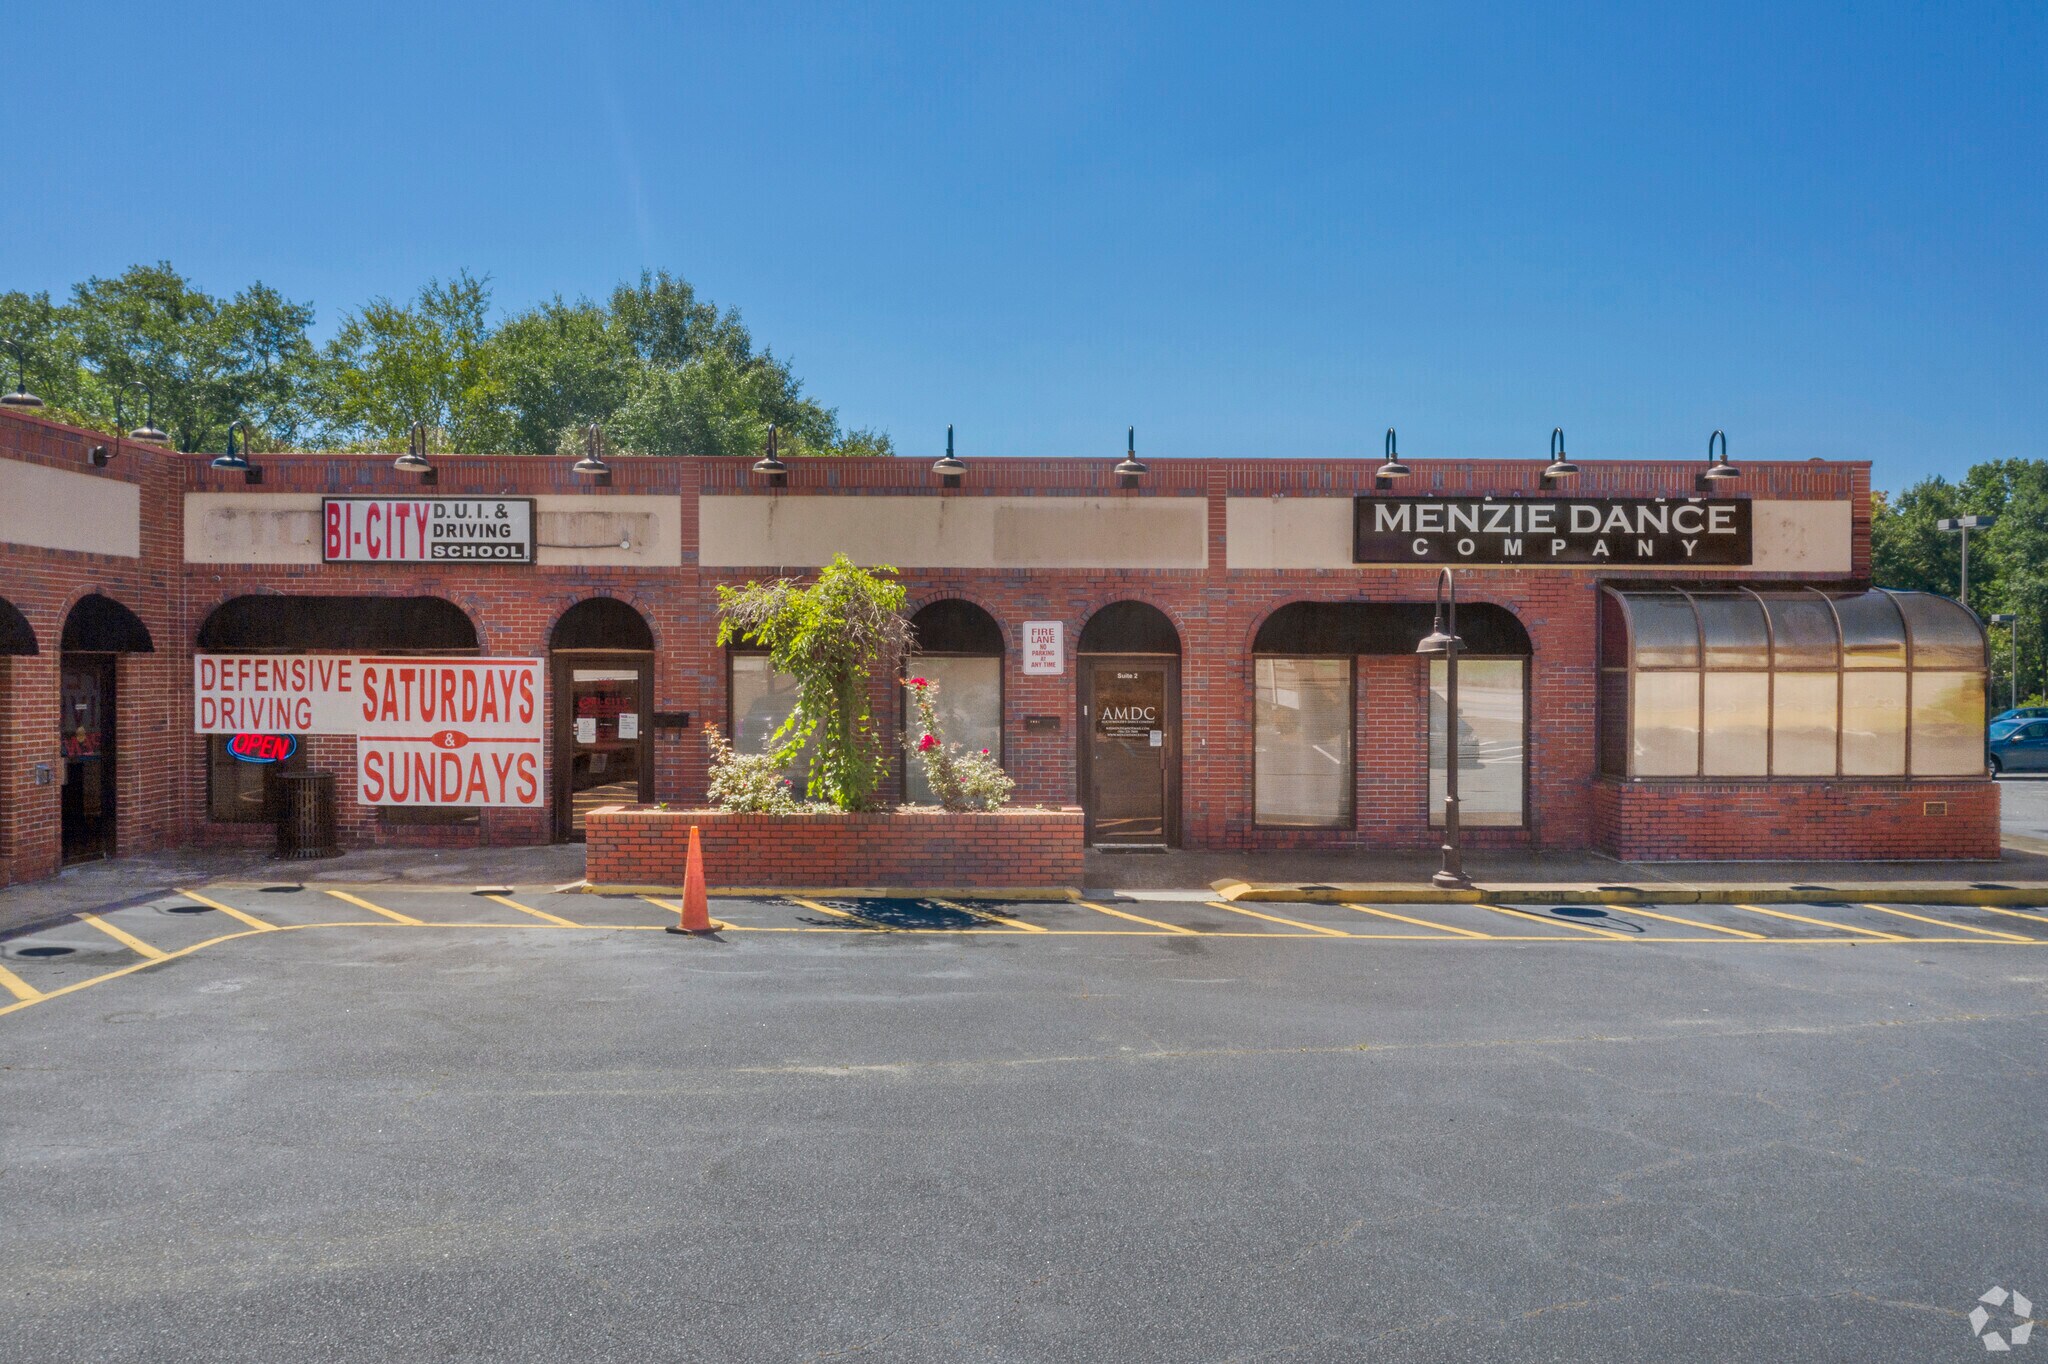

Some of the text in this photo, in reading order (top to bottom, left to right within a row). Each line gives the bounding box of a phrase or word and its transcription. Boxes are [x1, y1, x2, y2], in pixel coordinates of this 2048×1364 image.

[494, 503, 509, 519] &
[1375, 503, 1737, 535] MENZIE DANCE
[326, 502, 430, 559] BI-CITY
[433, 523, 511, 538] DRIVING
[433, 545, 522, 558] SCHOOL
[1412, 538, 1699, 556] COMPANY
[1031, 628, 1055, 636] FIRE
[201, 659, 352, 692] DEFENSIVE
[362, 667, 535, 724] SATURDAYS
[201, 697, 312, 730] DRIVING
[1102, 706, 1156, 720] AMDC
[233, 733, 290, 760] OPEN
[444, 733, 455, 748] &
[362, 750, 538, 804] SUNDAYS
